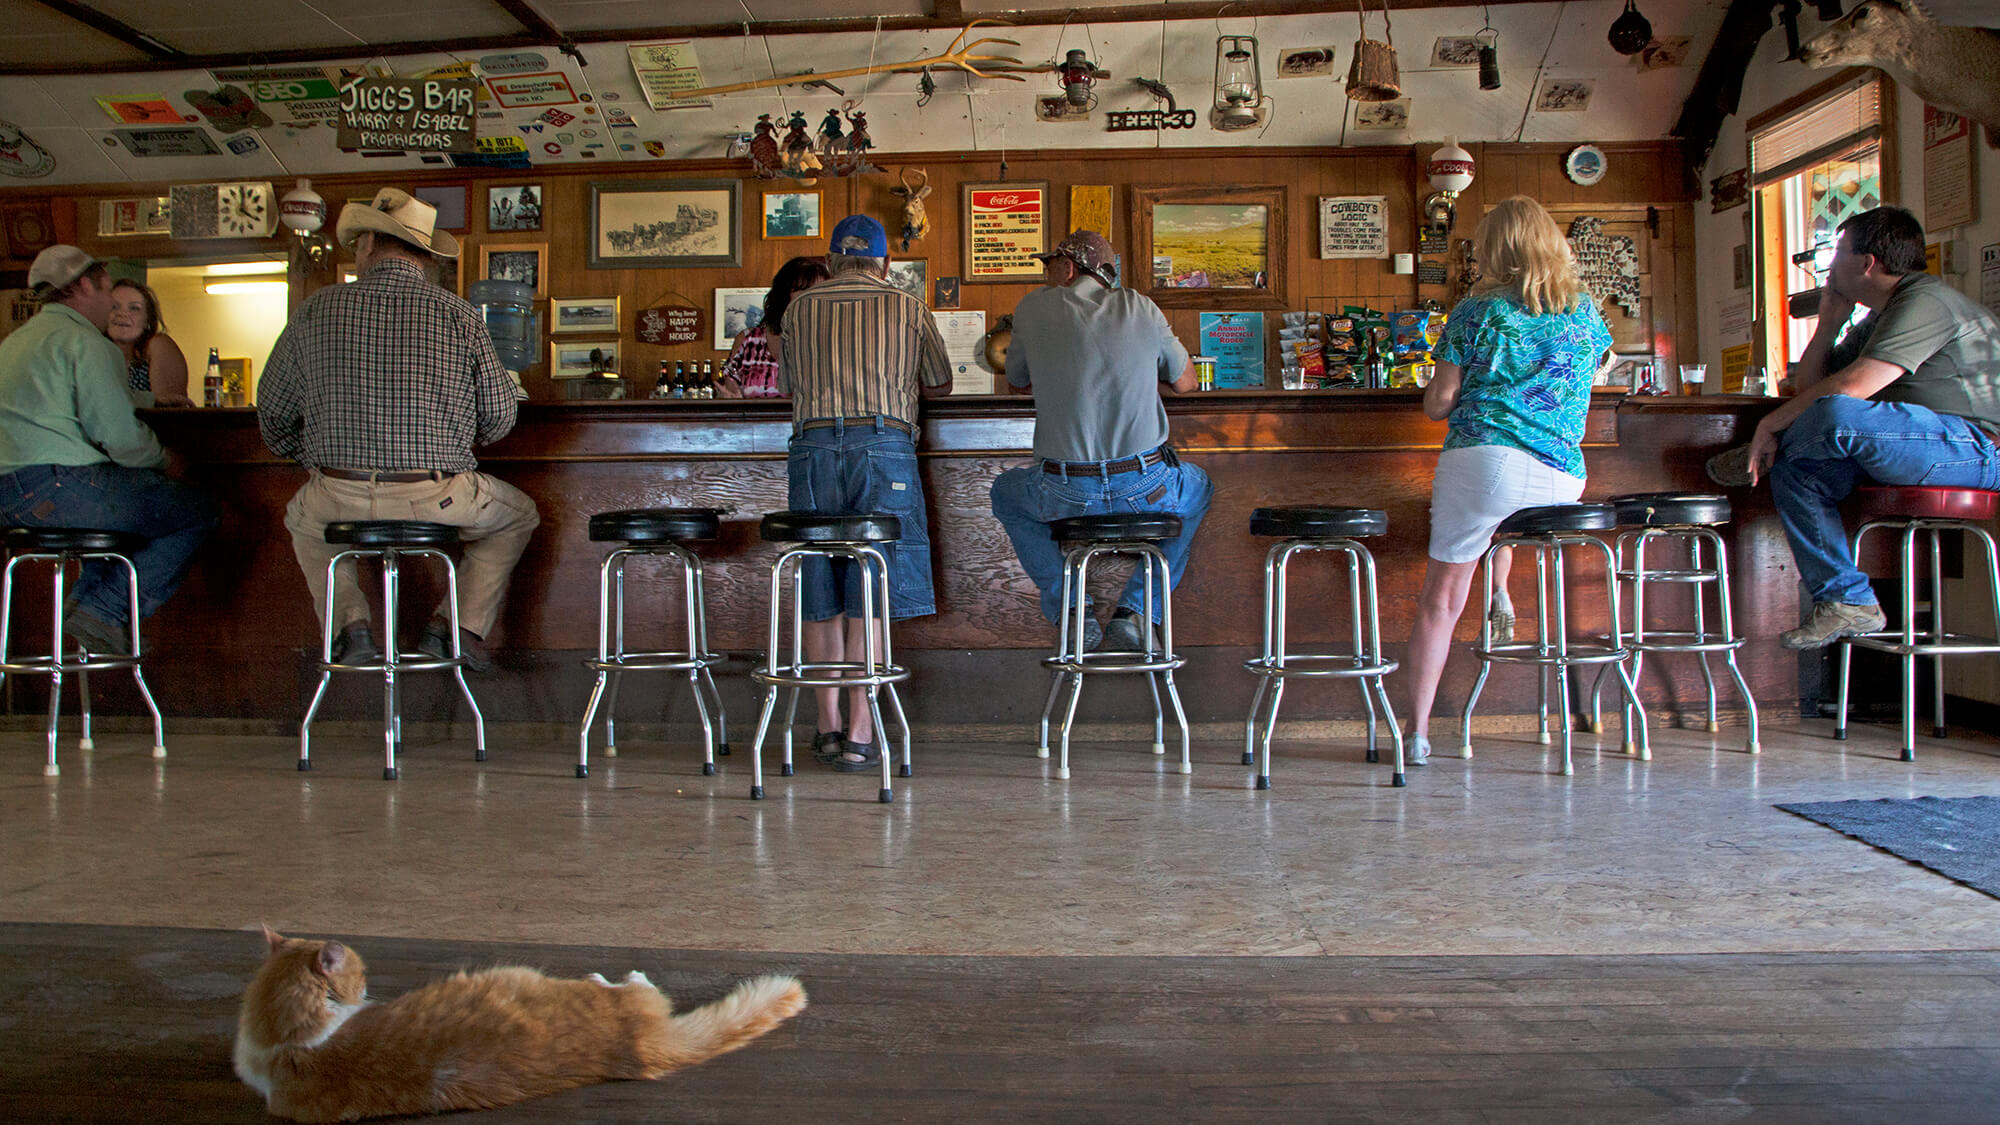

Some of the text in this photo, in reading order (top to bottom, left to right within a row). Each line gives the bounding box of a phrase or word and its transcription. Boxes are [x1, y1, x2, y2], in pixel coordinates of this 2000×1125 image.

[340, 77, 474, 117] JIGGS BAR
[292, 111, 340, 120] Servic
[345, 112, 393, 131] HARRY
[412, 111, 470, 131] ISABEL
[360, 131, 452, 148] PROPRIETORS
[495, 137, 514, 148] RITZ
[1331, 202, 1378, 214] COWBOY'S
[1341, 213, 1368, 221] LOGIC
[669, 318, 697, 326] HAPPY
[669, 332, 697, 341] HOUR?
